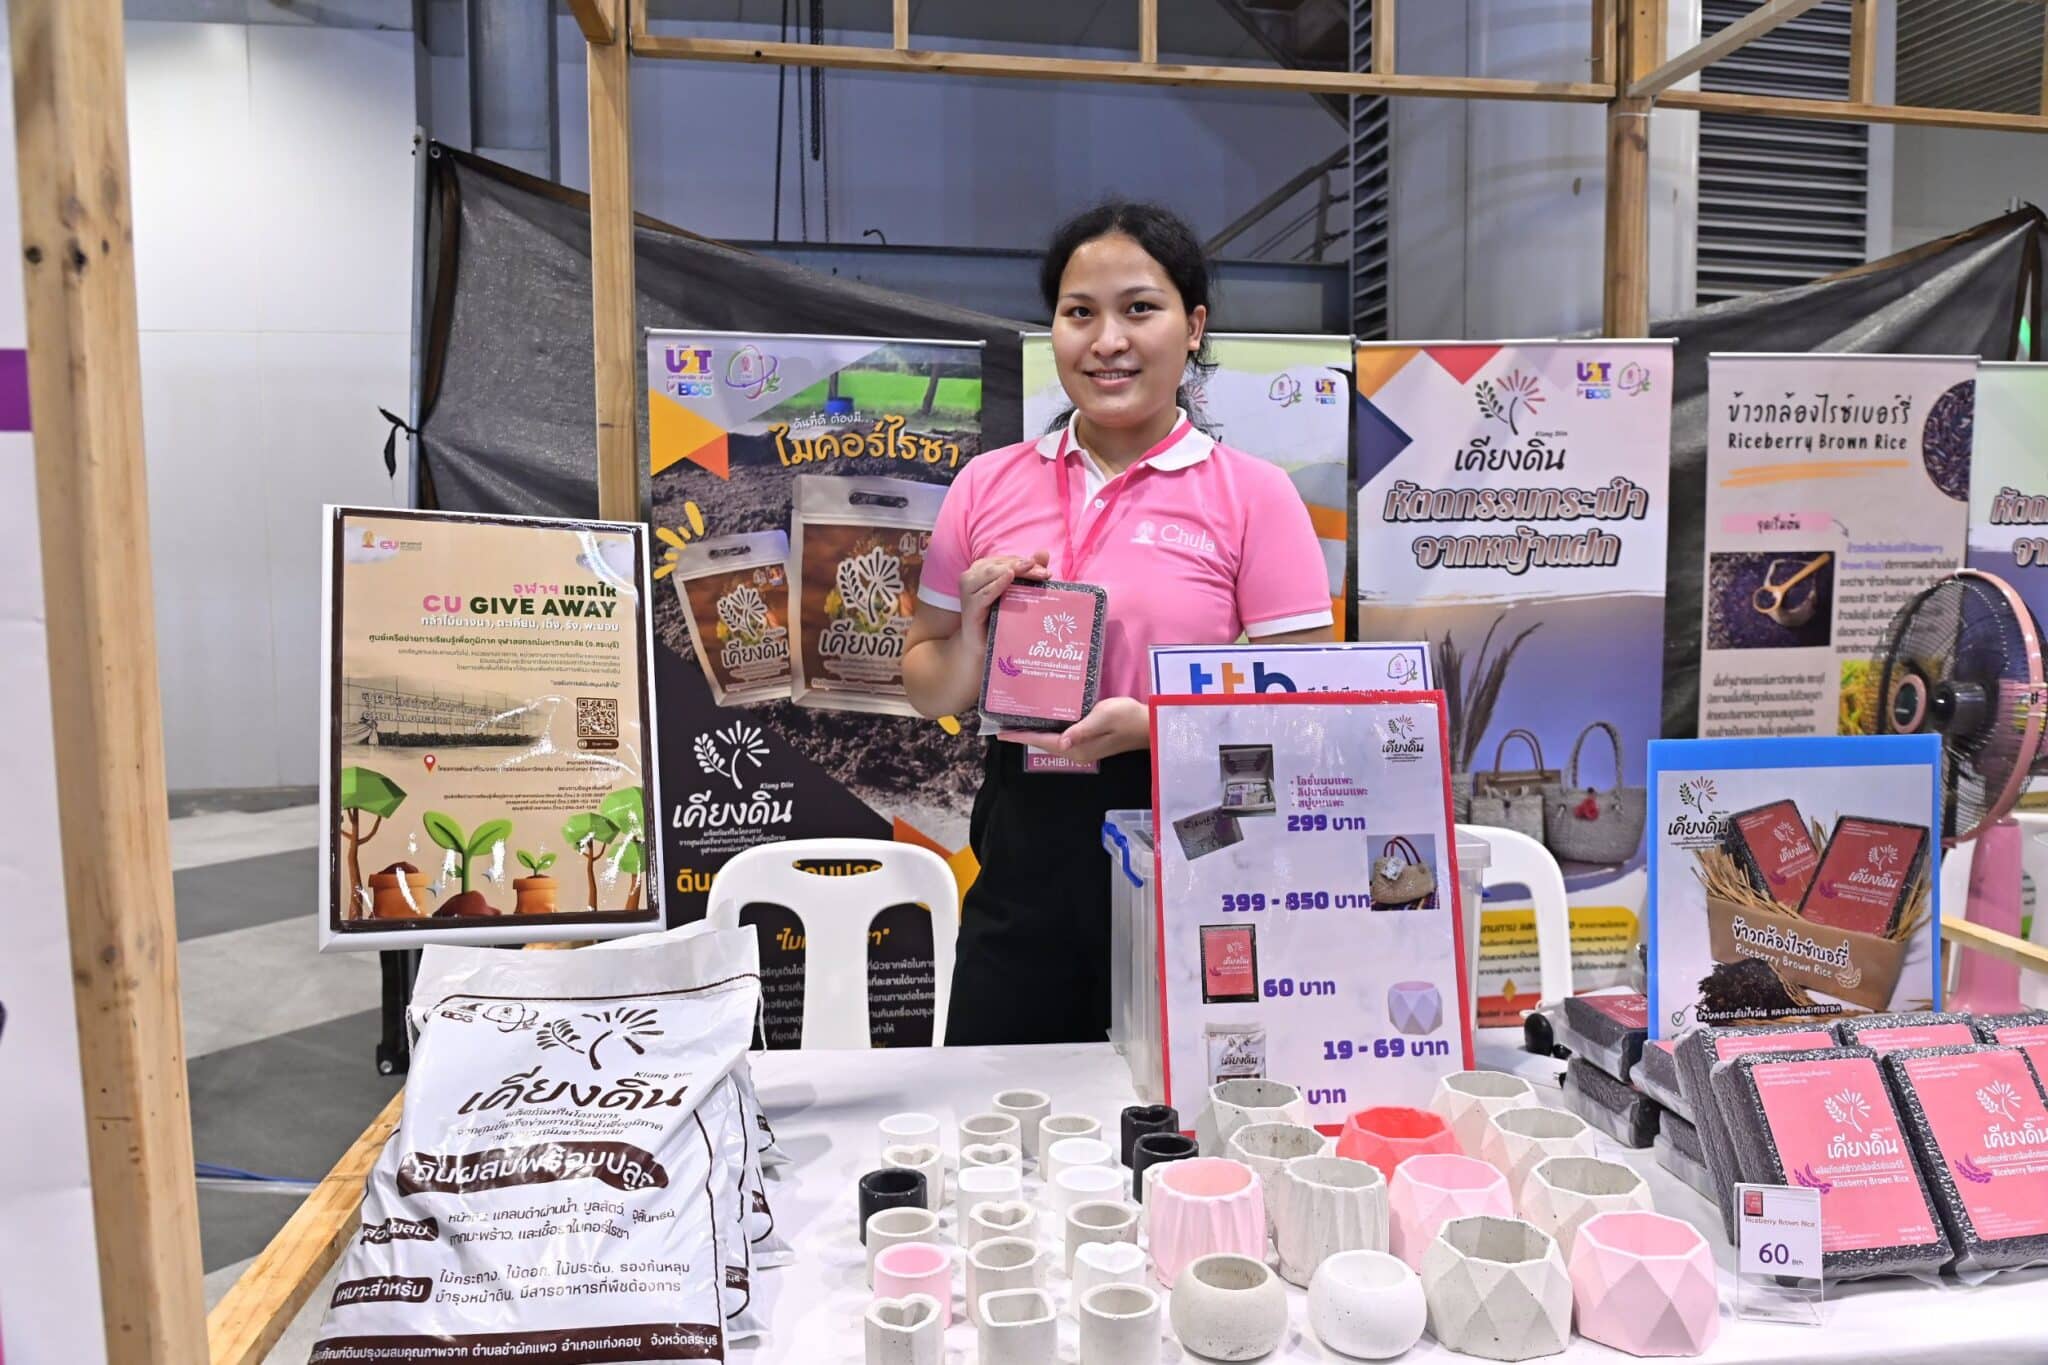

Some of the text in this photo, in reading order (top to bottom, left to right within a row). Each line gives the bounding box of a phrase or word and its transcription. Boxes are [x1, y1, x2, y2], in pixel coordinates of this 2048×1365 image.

[678, 383, 712, 396] BCG
[1728, 391, 1912, 424] ข้าวกล้องไรซ์เบอร์รี่
[768, 413, 961, 467] ไมคอร์ไรซา
[1728, 433, 1907, 453] Riceberry Brown Rice
[1454, 436, 1567, 472] เคียงดิน
[1383, 476, 1648, 522] หัตถกรรมกระเป๋า
[1160, 524, 1217, 553] Chula
[1412, 526, 1622, 575] จากหญ้าแฝก
[422, 594, 616, 618] CU GIVE AWAY
[819, 621, 903, 657] เคียงดิ
[1028, 639, 1084, 661] เคียงดิน
[1033, 756, 1092, 768] EXHIBI
[672, 789, 793, 829] เคียงดิน
[1287, 814, 1366, 832] 299 บาท
[1668, 814, 1729, 835] เคียงดิน
[1221, 893, 1265, 912] 399
[1285, 891, 1329, 910] 850
[1334, 893, 1370, 909] บาท
[1732, 916, 1850, 967] ข้าวกล้องไรซ์เบอร์รี่
[1735, 943, 1833, 978] Riceberry Brown Rice
[1263, 978, 1336, 997] 60 บาท
[1323, 1040, 1353, 1060] 19
[1374, 1038, 1405, 1058] 69
[1411, 1041, 1449, 1057] บาท
[458, 1065, 688, 1115] เคียงดิน
[1307, 1088, 1347, 1105] บาท
[1826, 1133, 1899, 1160] เคียงดิน
[1832, 1174, 1910, 1189] Riceberry Brown Rice
[1759, 1243, 1789, 1264] 60
